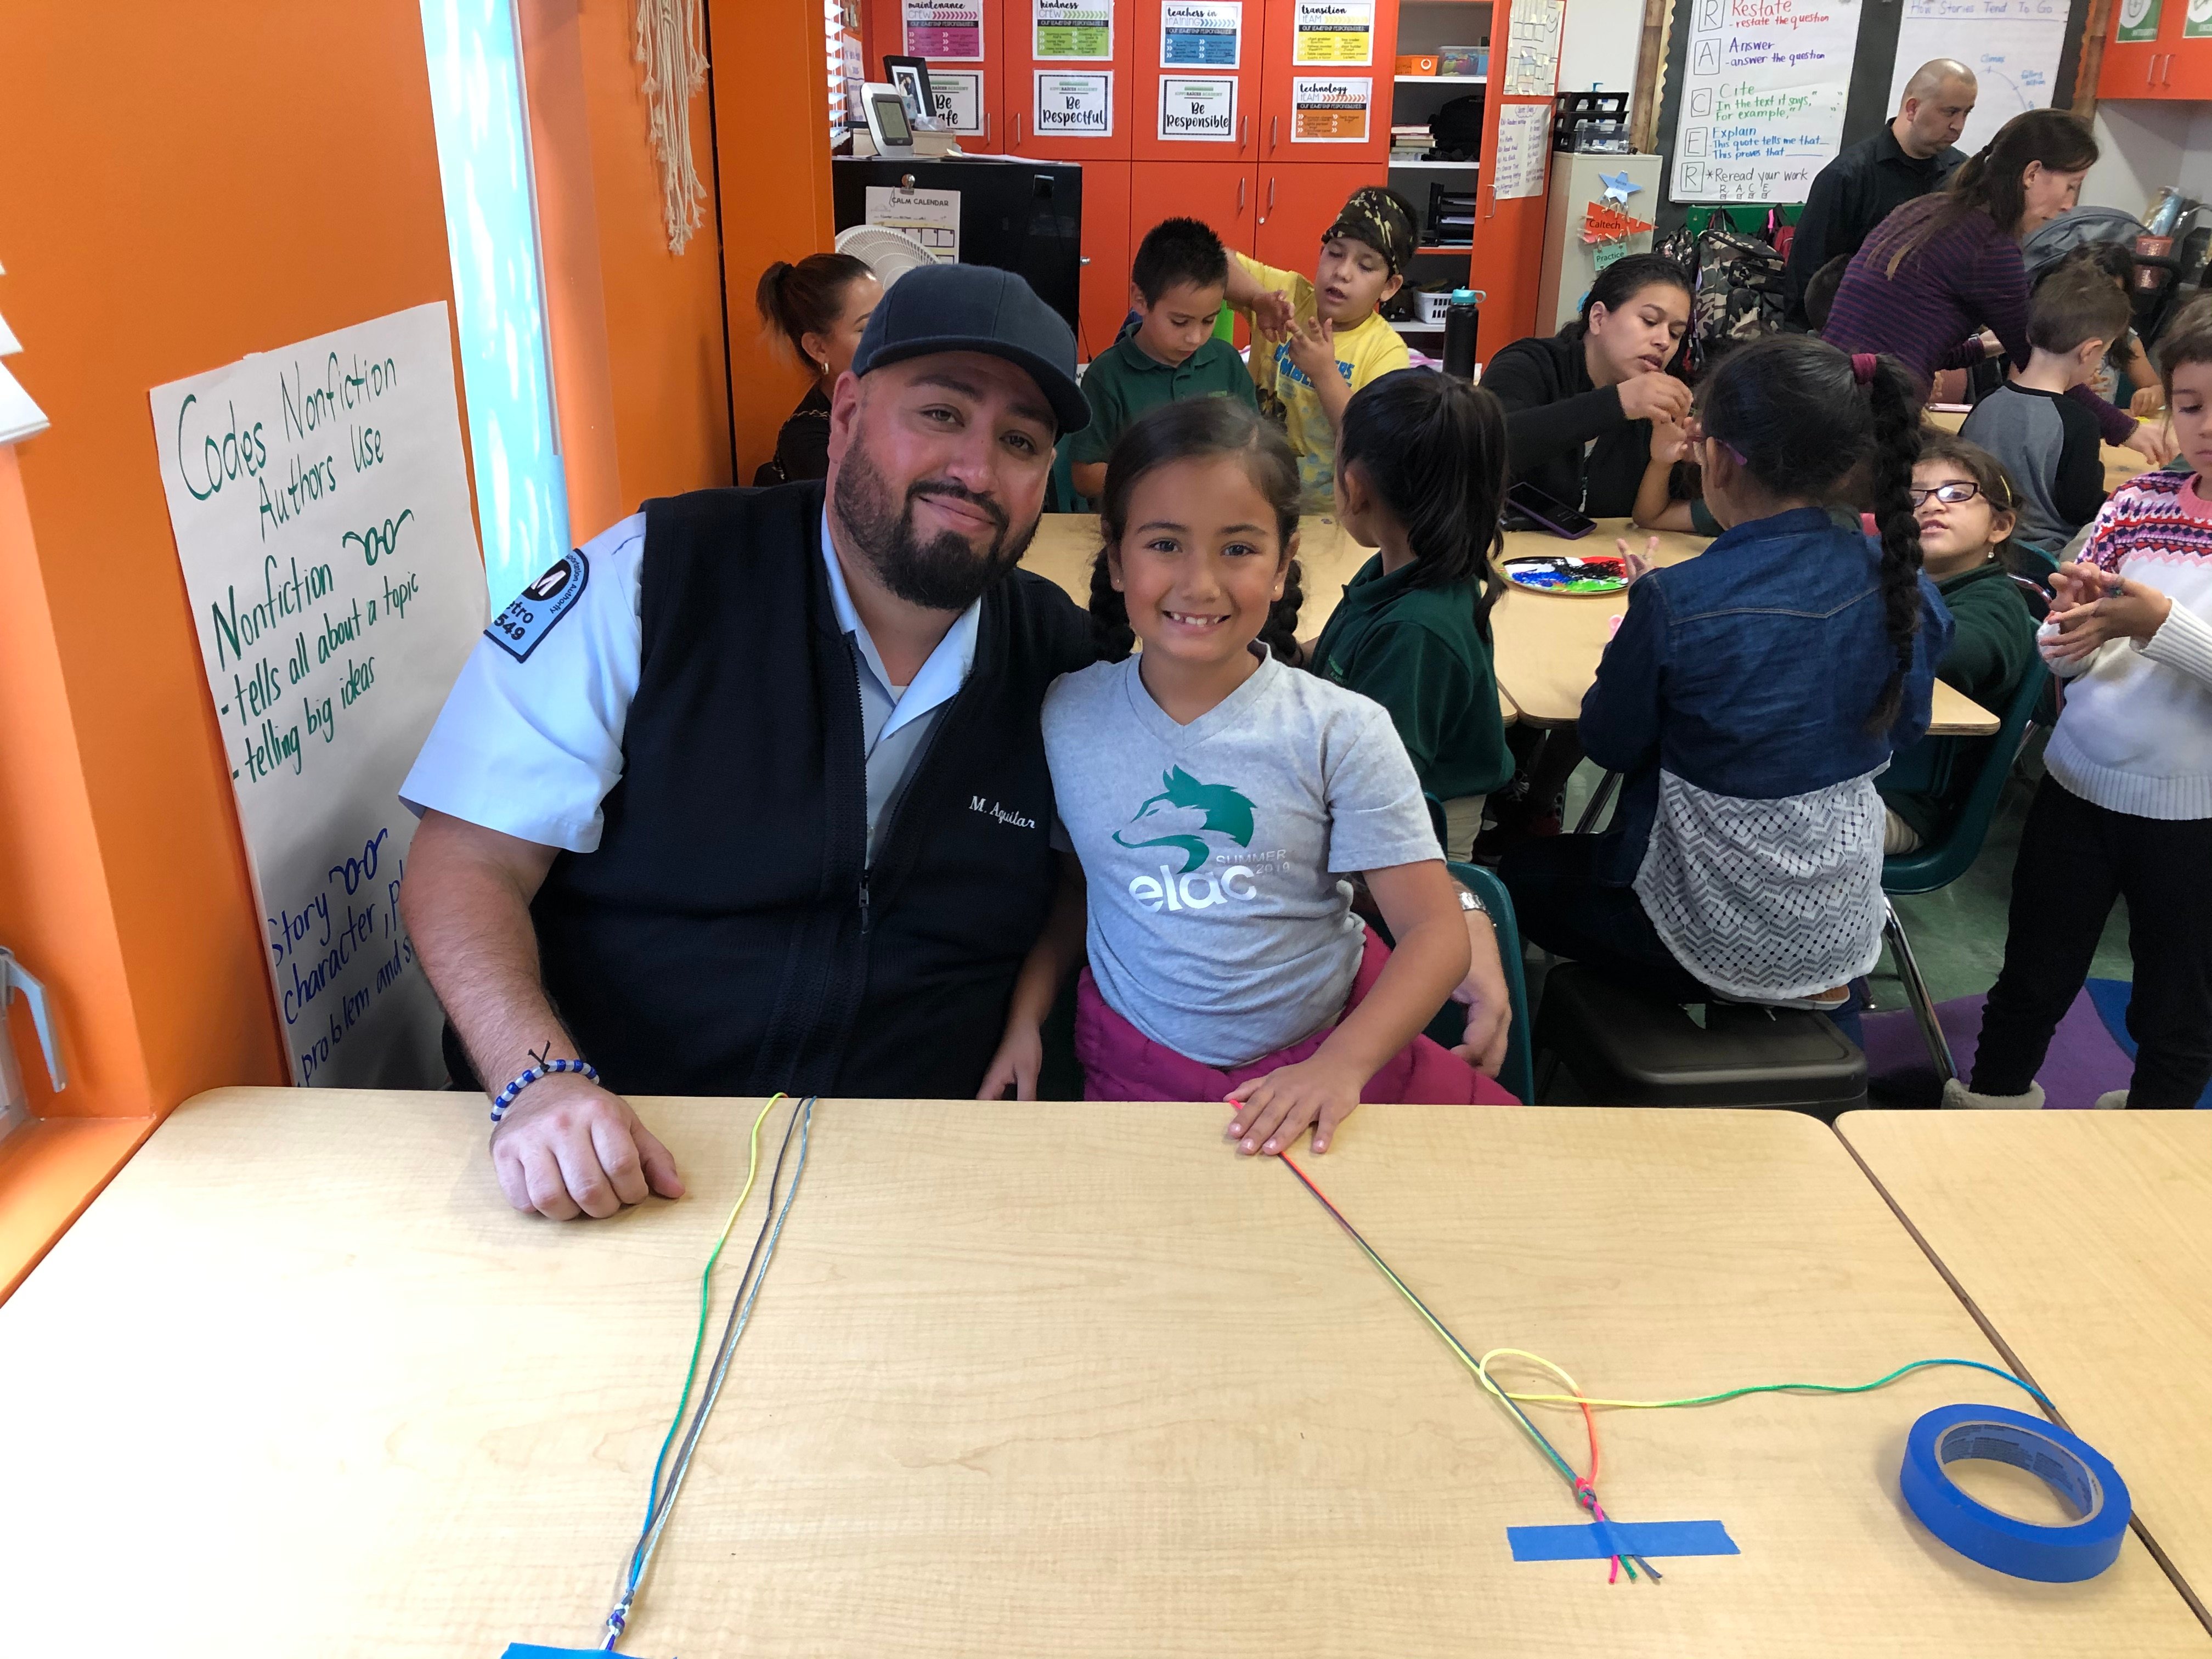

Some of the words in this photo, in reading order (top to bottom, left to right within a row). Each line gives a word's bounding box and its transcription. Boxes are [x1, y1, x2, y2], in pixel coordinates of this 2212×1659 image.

[909, 0, 966, 9] maintenance
[1040, 0, 1079, 9] kindness
[1167, 7, 1205, 17] teachers
[1301, 4, 1347, 14] transition
[1732, 0, 1792, 17] Restate
[1984, 1, 2007, 13] Tend
[2019, 2, 2030, 13] To
[2037, 1, 2053, 13] Go
[1775, 16, 1788, 25] the
[1791, 12, 1829, 30] question
[1729, 37, 1775, 53] Answer
[1699, 42, 1713, 66] A
[1771, 53, 1786, 63] the
[1789, 49, 1825, 67] question
[1300, 83, 1348, 97] technology
[1720, 81, 1754, 98] Cite
[935, 94, 951, 109] Be
[1066, 96, 1080, 110] Be
[1192, 101, 1205, 115] Be
[1693, 93, 1706, 112] C
[1716, 101, 1730, 111] In
[1735, 99, 1751, 109] the
[1754, 95, 1774, 107] text
[1779, 94, 1786, 105] it
[1043, 109, 1104, 126] Respectful
[1167, 114, 1228, 131] Responsible
[1716, 111, 1733, 121] For
[1713, 126, 1756, 141] Explain
[1688, 132, 1701, 154] E
[1734, 138, 1759, 151] quote
[1763, 136, 1781, 145] tells
[1735, 149, 1760, 160] proves
[1766, 147, 1784, 156] that
[1685, 165, 1697, 188] R
[1758, 171, 1780, 187] your
[1784, 167, 1808, 182] work
[1736, 184, 1742, 192] A
[1748, 183, 1754, 192] C
[1763, 183, 1769, 191] E
[913, 198, 949, 206] CALENDAR
[1590, 219, 1621, 229] Caltech
[1596, 252, 1624, 262] Practice
[178, 394, 266, 500] Codes
[280, 352, 397, 442] Nonfiction
[259, 454, 336, 543] Authors
[351, 424, 383, 473] Use
[212, 555, 334, 672] Nonfiction
[289, 632, 311, 685] all
[318, 598, 362, 664] about
[367, 600, 377, 625] a
[383, 571, 419, 619] topic
[304, 697, 334, 743] big
[340, 656, 375, 709] ideas
[968, 795, 987, 813] M.
[989, 802, 1035, 828] Aguilar
[1216, 849, 1286, 865] SUMMER
[1256, 861, 1290, 874] 2019
[1128, 865, 1257, 913] elac
[268, 893, 330, 967] Story
[302, 988, 369, 1087] problem
[377, 940, 402, 994] and
